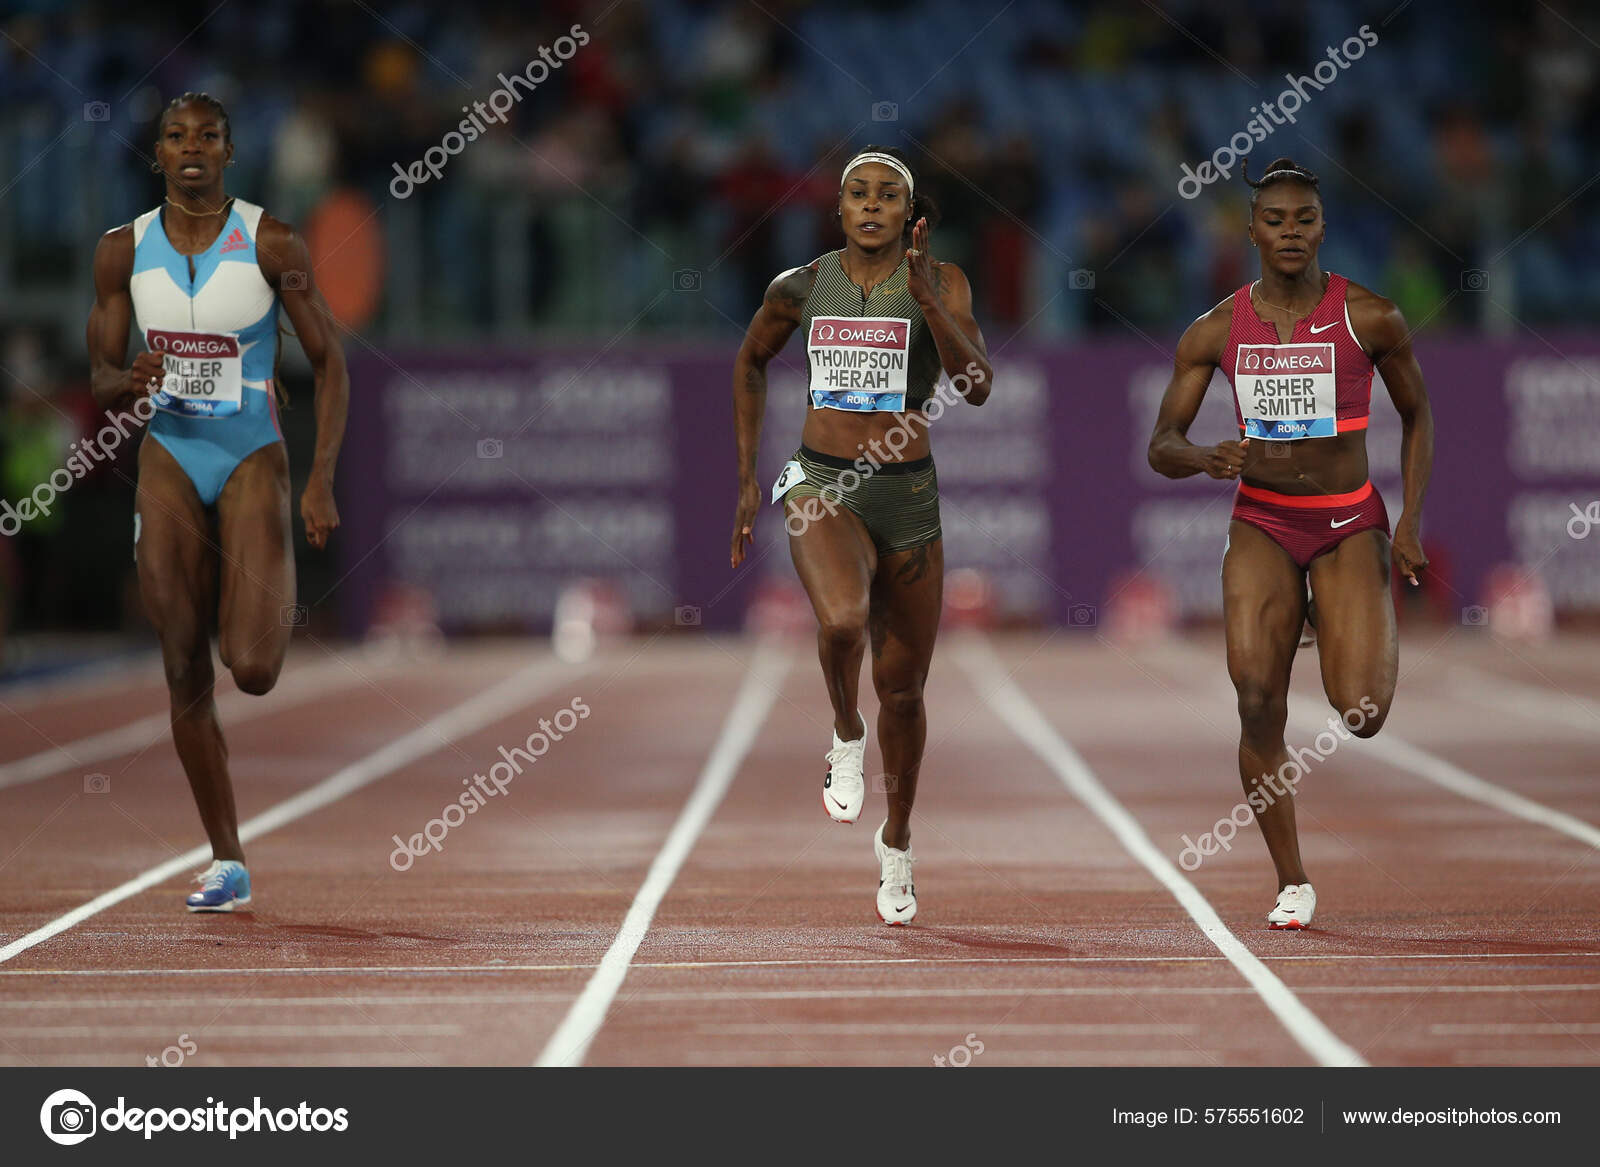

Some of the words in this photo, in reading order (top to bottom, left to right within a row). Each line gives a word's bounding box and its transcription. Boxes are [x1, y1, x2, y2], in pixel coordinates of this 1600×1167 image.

[839, 328, 898, 343] OMEGA
[172, 340, 231, 353] OMEGA
[811, 349, 904, 370] THOMPSON
[1263, 355, 1324, 370] OMEGA
[824, 369, 889, 388] -HERAH
[1253, 377, 1315, 397] ASHER
[846, 395, 876, 405] ROMA
[1254, 397, 1316, 416] -SMITH
[1277, 424, 1308, 433] ROMA
[778, 466, 791, 488] 6
